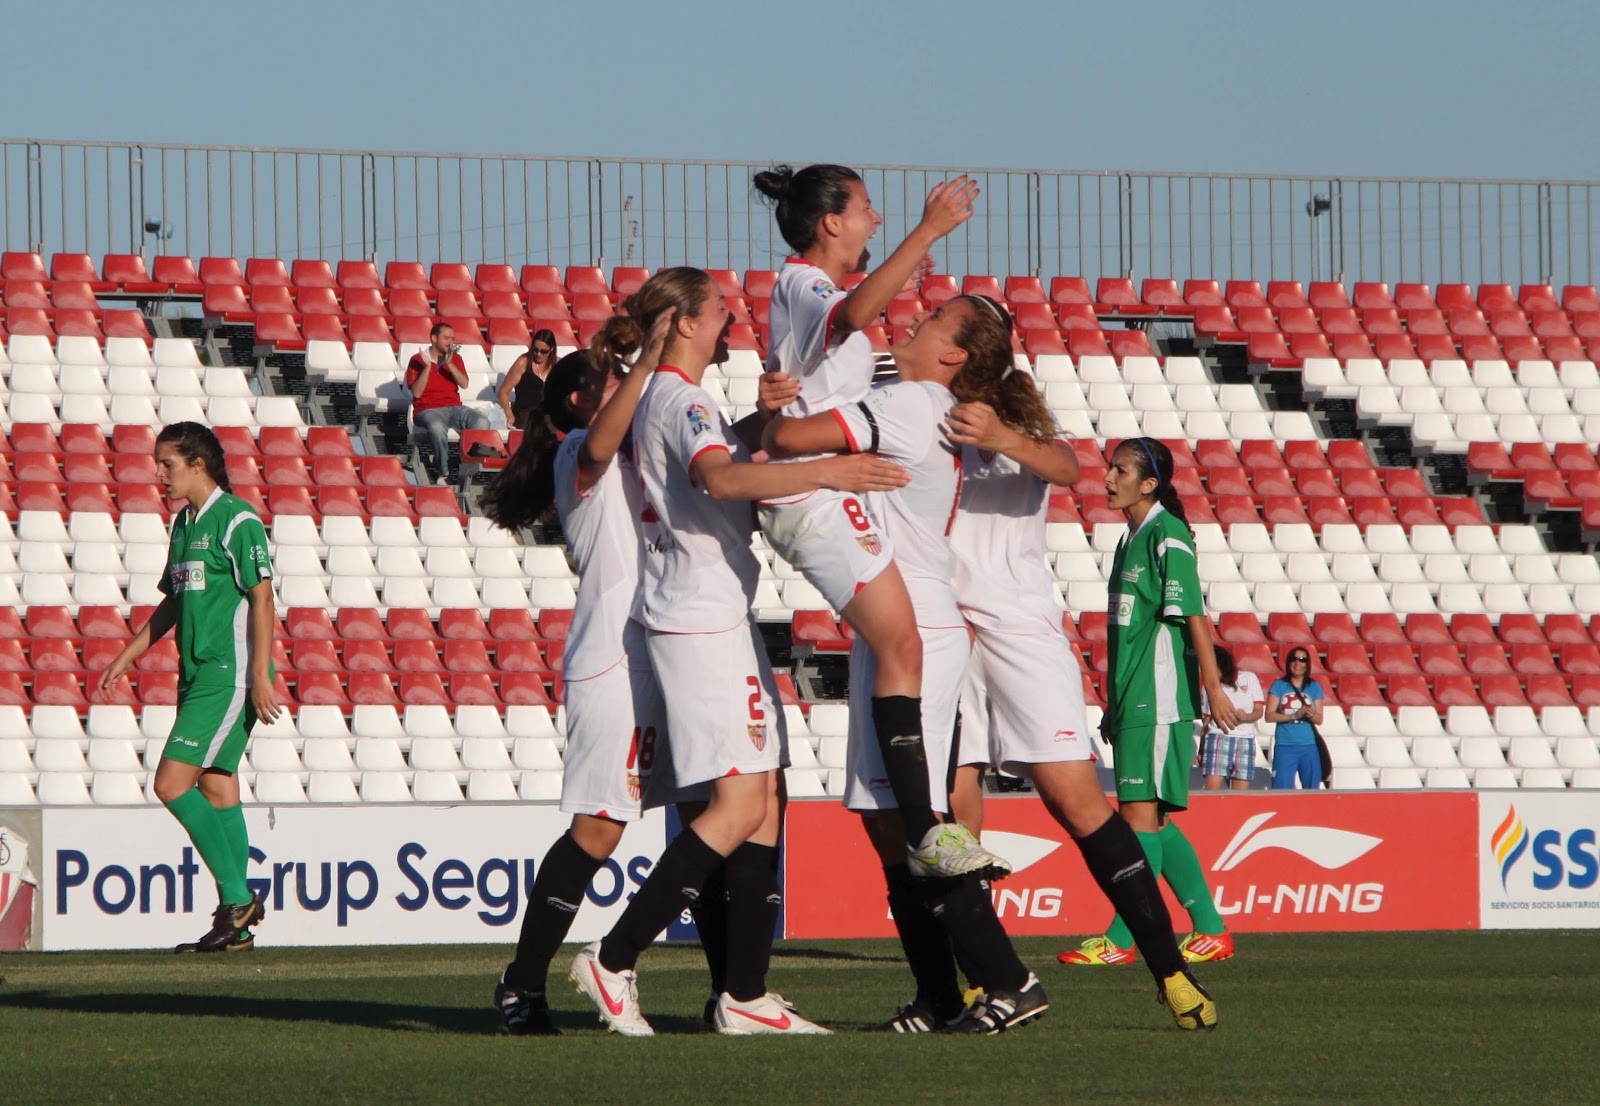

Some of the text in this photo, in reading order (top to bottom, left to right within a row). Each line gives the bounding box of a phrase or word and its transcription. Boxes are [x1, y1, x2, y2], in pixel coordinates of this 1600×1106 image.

[842, 497, 870, 532] 8
[745, 674, 765, 721] 2
[626, 726, 657, 770] 18
[56, 846, 200, 915] Pont
[395, 841, 653, 927] Segos
[1213, 882, 1385, 916] LI-NING
[1490, 901, 1530, 910] SERVICIOS
